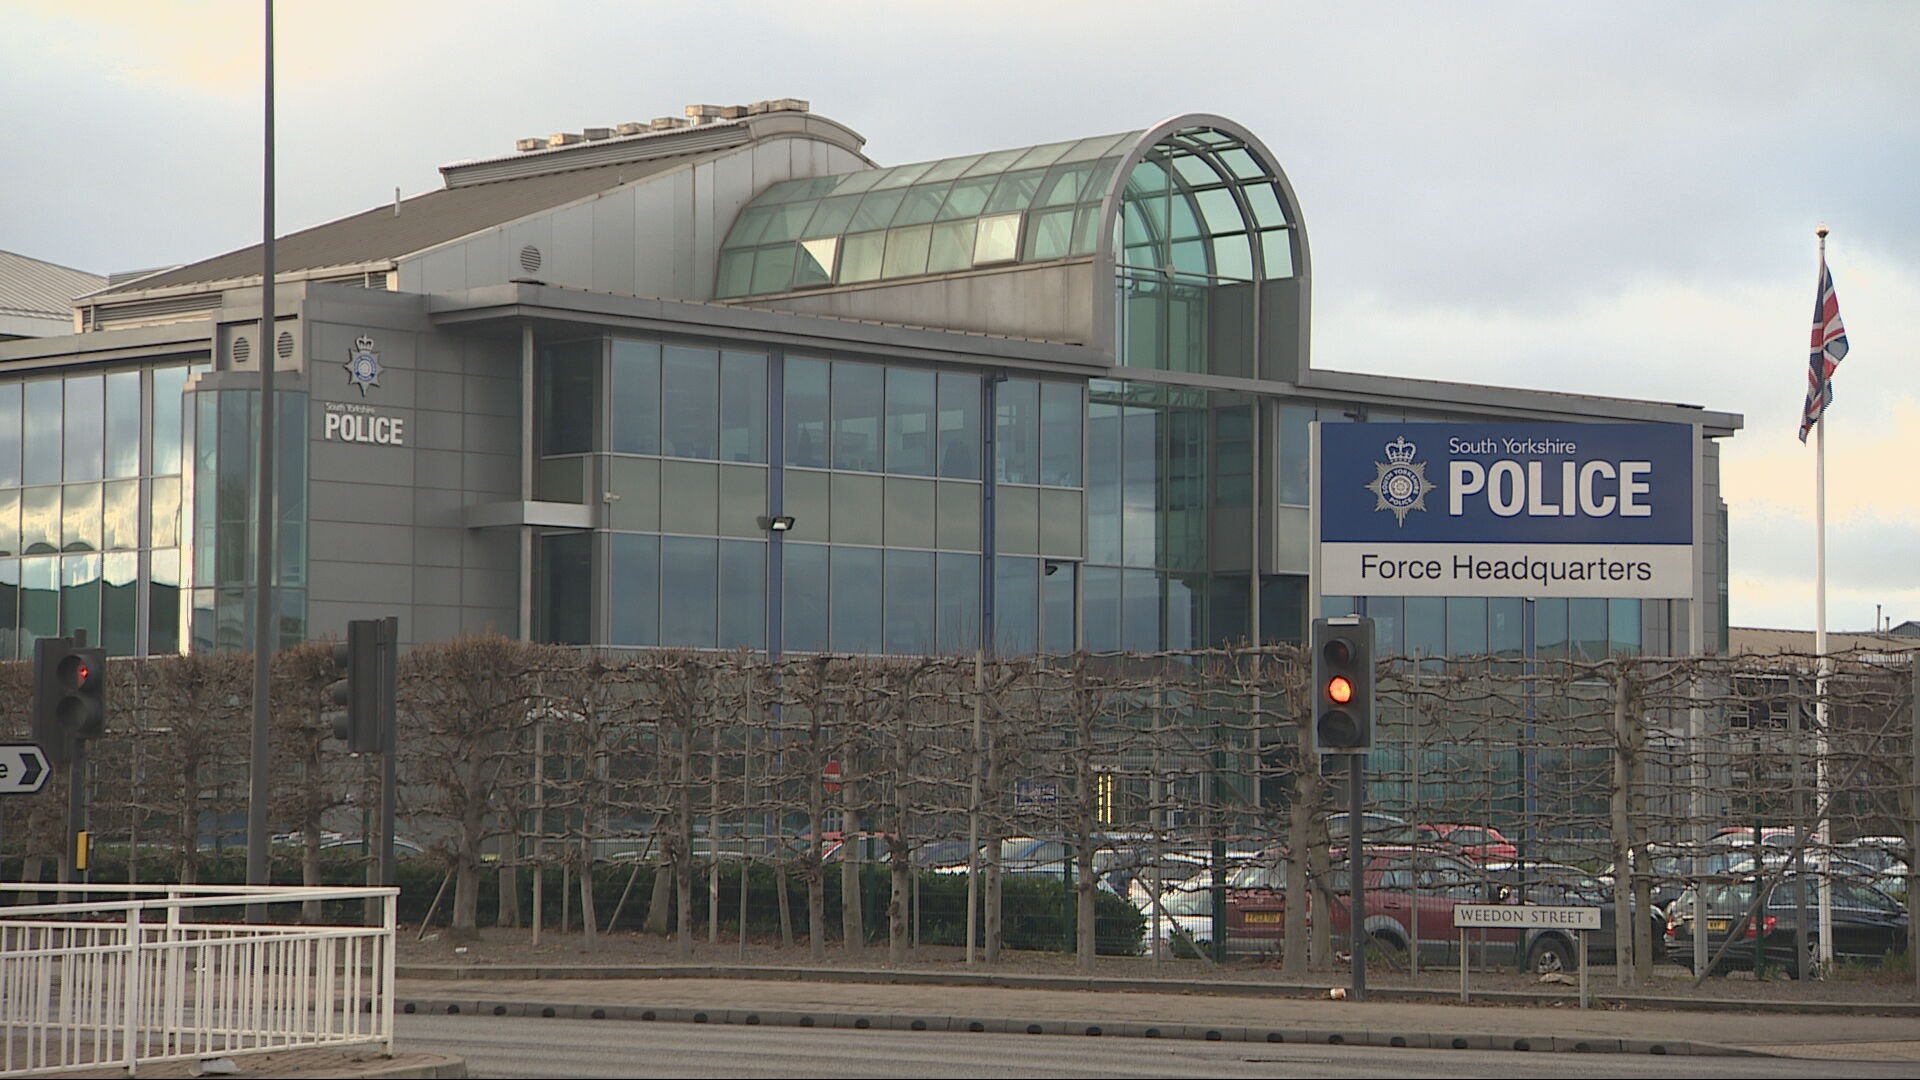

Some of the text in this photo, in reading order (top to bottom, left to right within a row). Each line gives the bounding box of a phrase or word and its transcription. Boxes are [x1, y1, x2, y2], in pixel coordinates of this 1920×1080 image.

[325, 412, 403, 445] POLICE
[1449, 437, 1576, 454] South Yorkshire
[1449, 460, 1652, 517] POLICE
[1361, 554, 1652, 587] Force Headquarters
[1461, 909, 1524, 922] WEEDON
[1532, 911, 1584, 924] STREET
